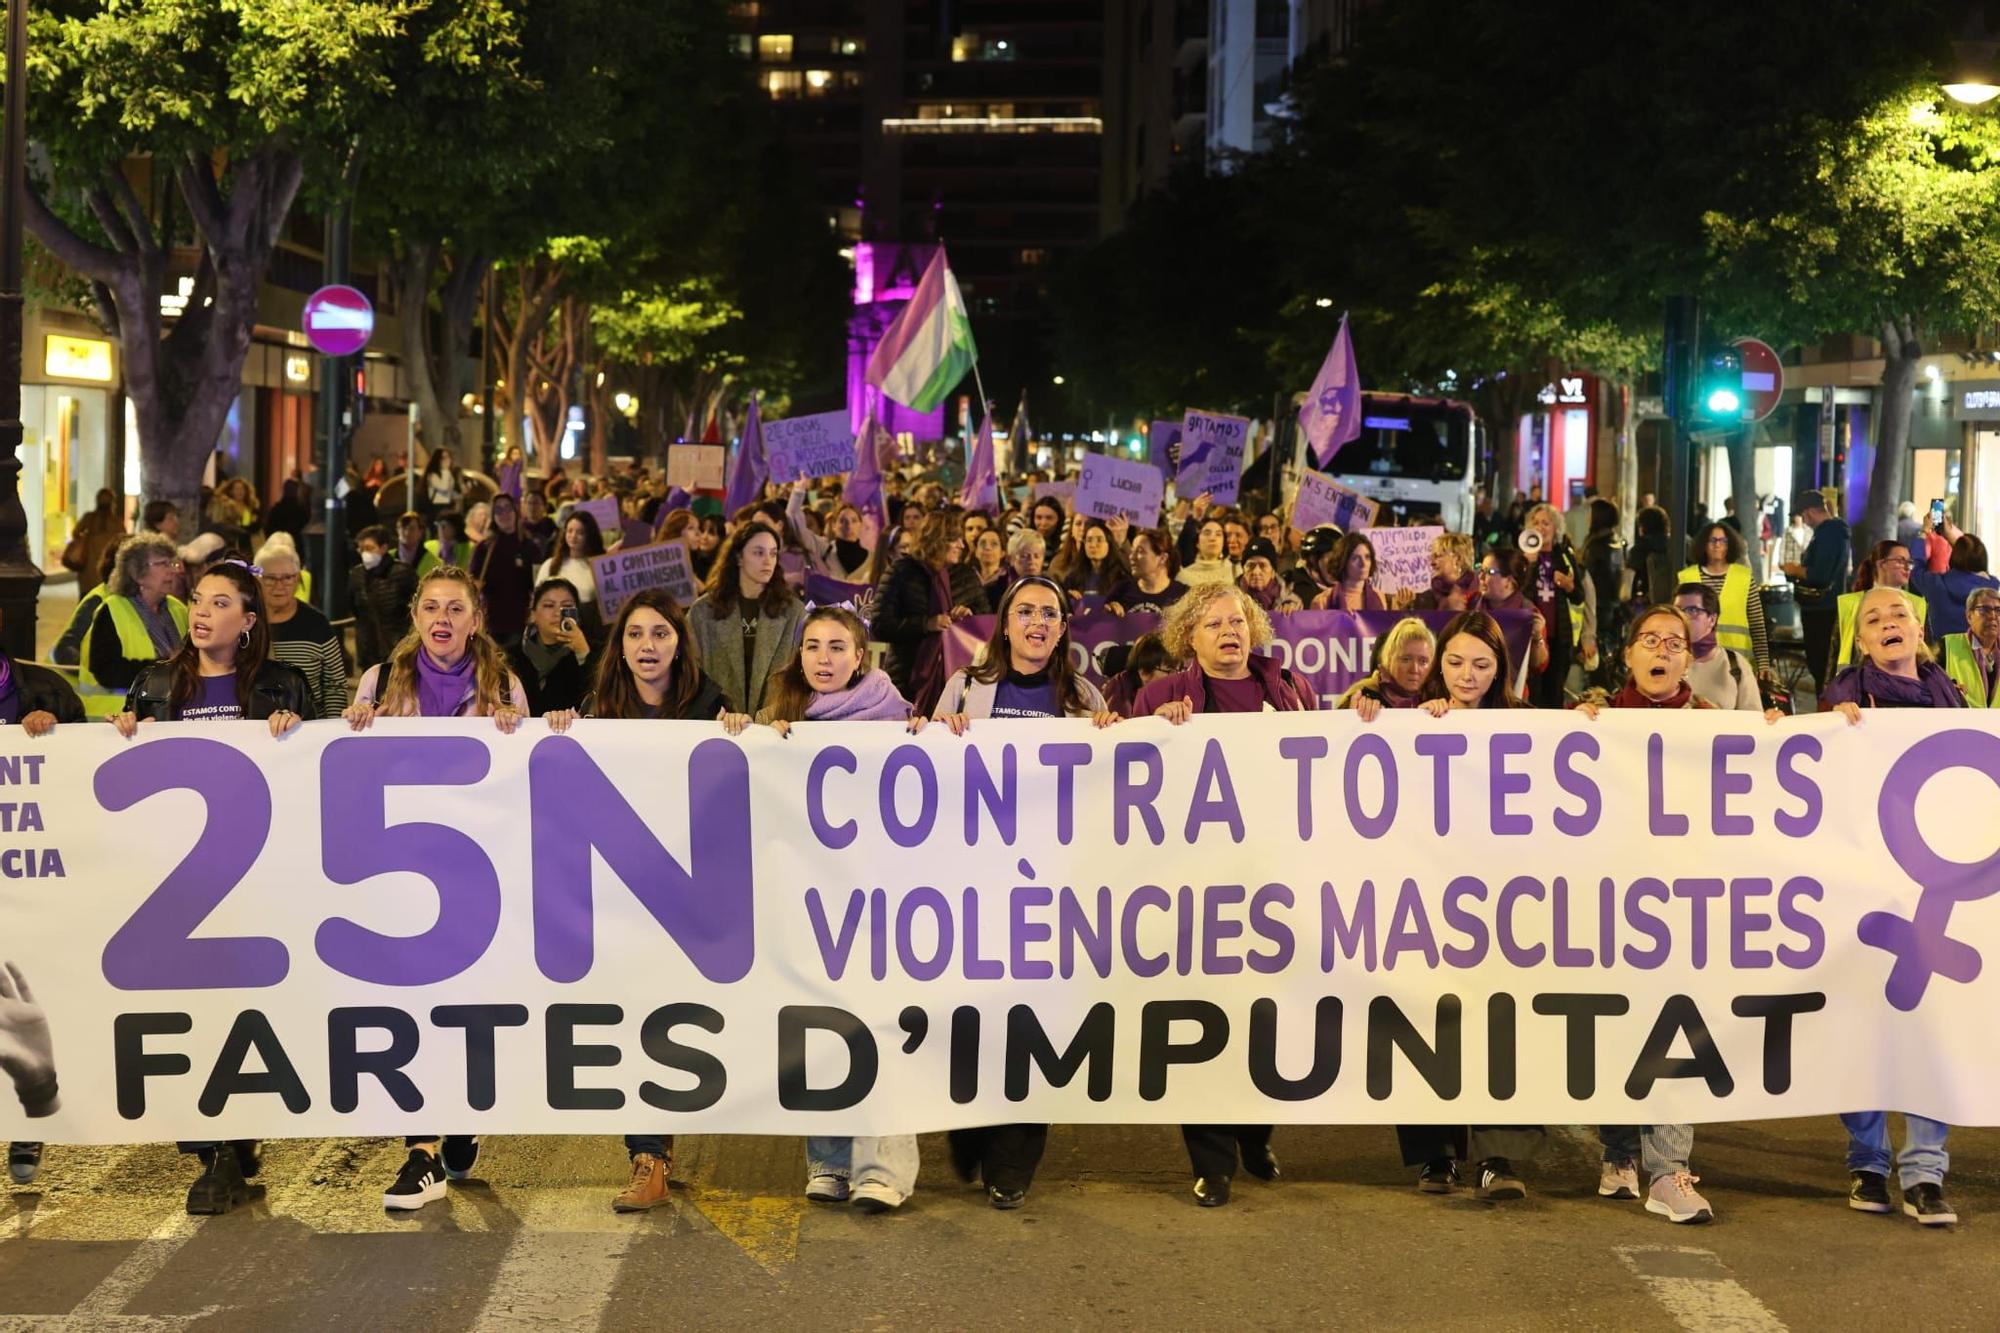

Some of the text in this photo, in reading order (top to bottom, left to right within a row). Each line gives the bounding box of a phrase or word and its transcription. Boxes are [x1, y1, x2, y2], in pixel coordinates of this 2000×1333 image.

[807, 455, 853, 475] VIVIRLO
[601, 547, 682, 576] LO CONTRARIO
[604, 577, 619, 594] AL
[622, 563, 685, 593] FEMINISMO
[183, 706, 217, 716] ESTAMOS
[807, 731, 1823, 849] CONTRA TOTES LES
[0, 848, 66, 878] CIA
[94, 735, 754, 990] 25N
[804, 858, 1826, 982] VIOLÈNCIES MASCLISTES
[114, 991, 1827, 1119] FARTES D'IMPUNITAT
